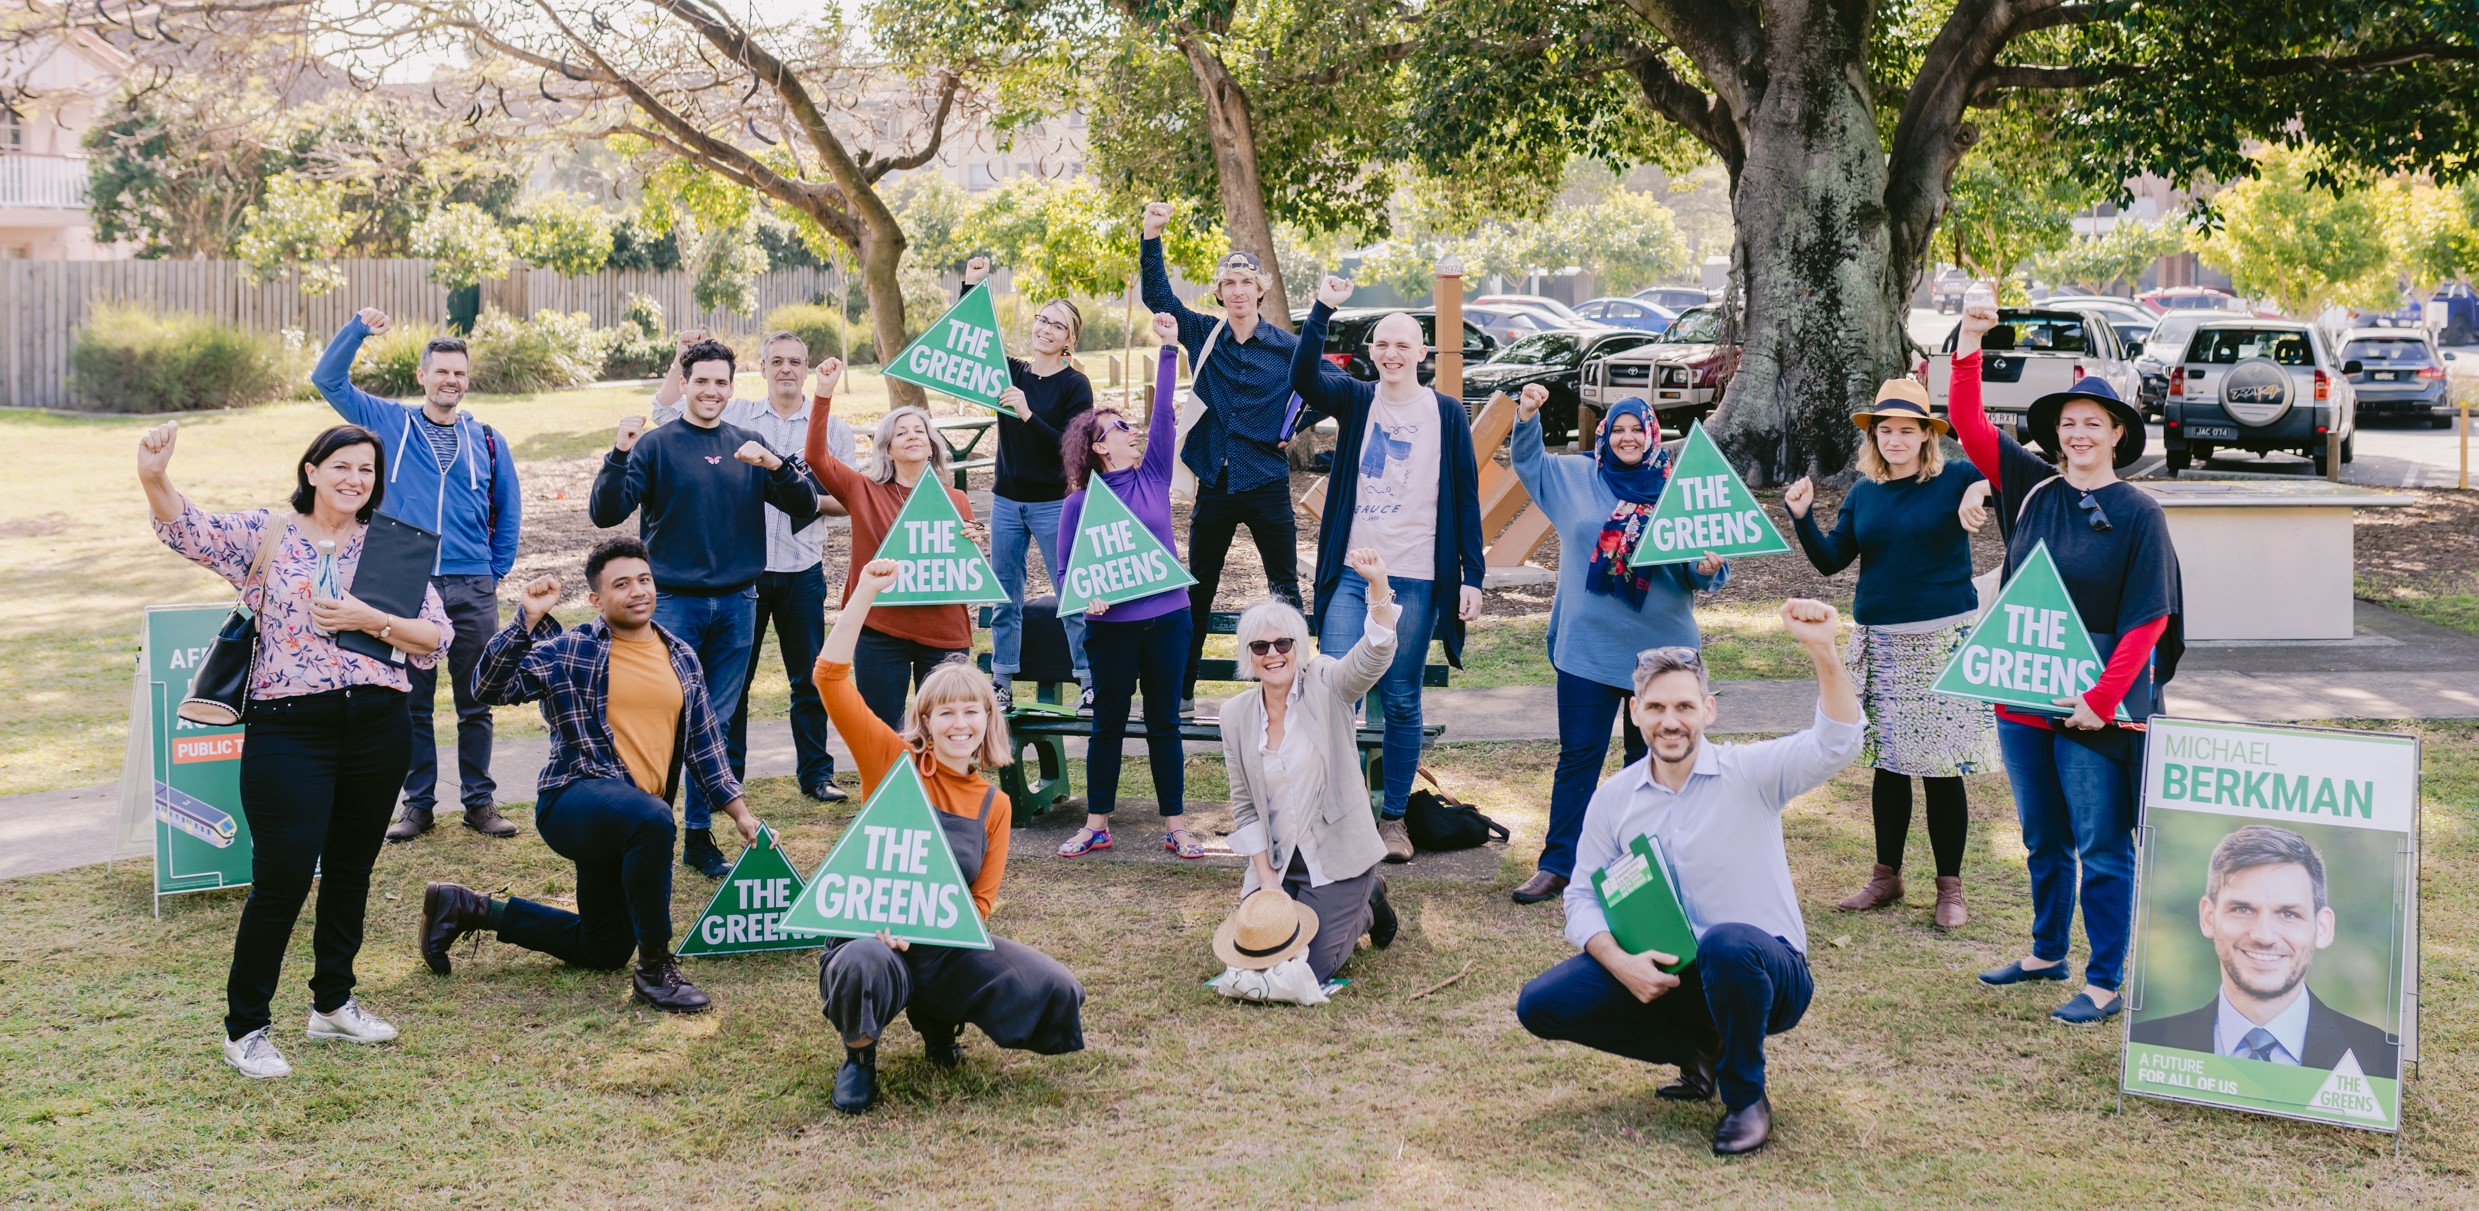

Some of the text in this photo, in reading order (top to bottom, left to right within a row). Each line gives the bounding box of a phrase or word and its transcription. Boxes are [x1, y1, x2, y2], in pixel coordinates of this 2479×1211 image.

[946, 318, 993, 359] THE
[909, 344, 1006, 398] GREENS
[1999, 413, 2015, 422] RXT
[1677, 474, 1731, 511] THE
[904, 520, 956, 554] THE
[1085, 519, 1136, 558] THE
[1652, 509, 1763, 552] GREENS
[1071, 549, 1168, 599] GREENS
[2003, 603, 2068, 650] THE
[1962, 644, 2097, 697] GREENS
[177, 740, 233, 758] PUBLIC
[2164, 733, 2278, 767] MICHAEL
[2162, 762, 2374, 820] BERKMAN
[863, 825, 932, 875] THE
[734, 877, 791, 910] THE
[815, 873, 960, 929] GREENS
[702, 911, 817, 945] GREE
[2138, 1067, 2238, 1095] FOR ALL OF US
[2139, 1052, 2205, 1075] A FUTURE
[2320, 1090, 2374, 1112] GREENS
[2335, 1074, 2361, 1093] THE
